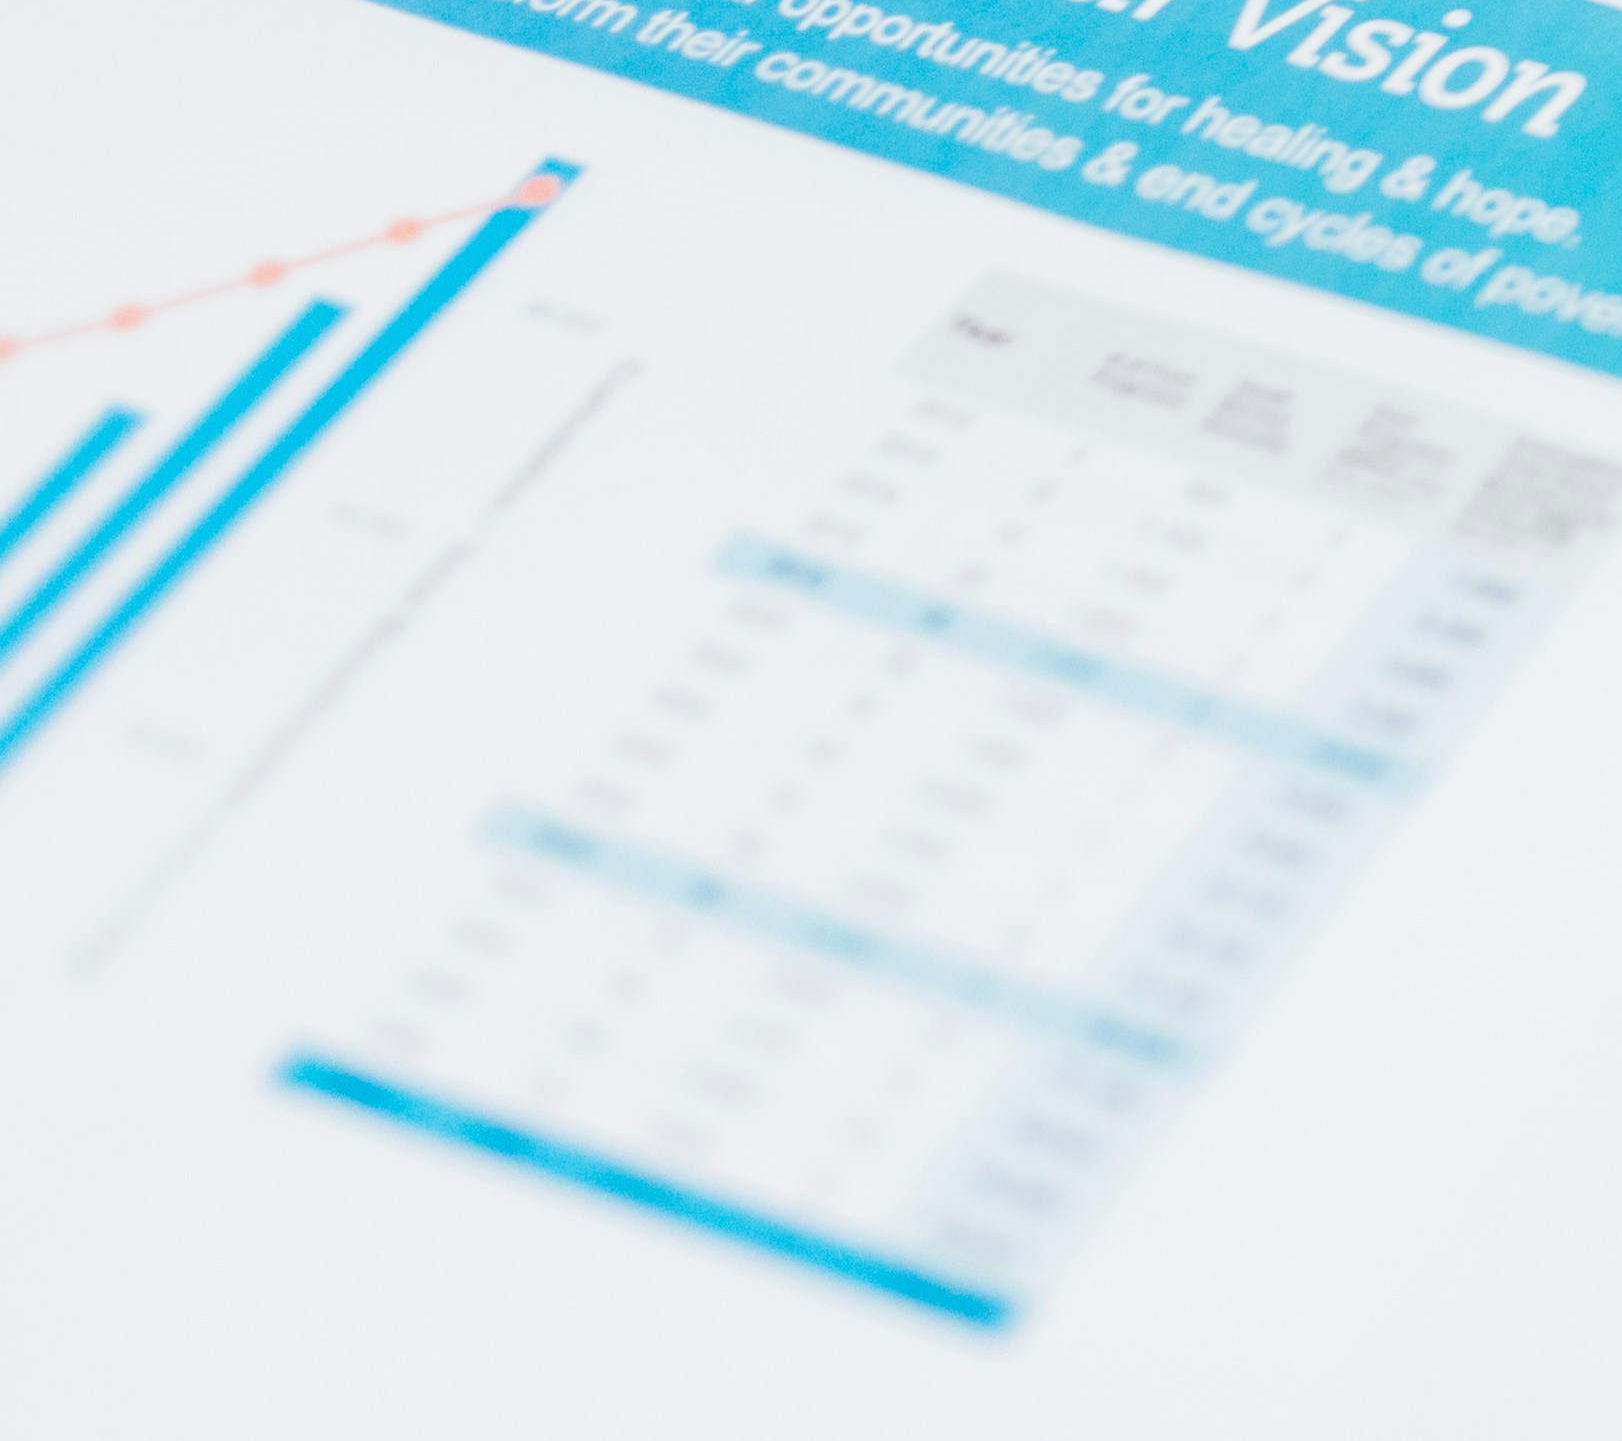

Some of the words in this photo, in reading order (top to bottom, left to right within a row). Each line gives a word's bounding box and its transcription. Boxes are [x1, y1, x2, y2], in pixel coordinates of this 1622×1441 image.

[636, 10, 764, 70] their
[754, 51, 1085, 172] communities
[1081, 140, 1140, 188] &
[1134, 163, 1259, 223] end
[1245, 196, 1425, 273] cycles
[1419, 246, 1504, 292] of
[1103, 72, 1191, 125] for
[1180, 95, 1384, 195] healing
[1379, 153, 1437, 202] &
